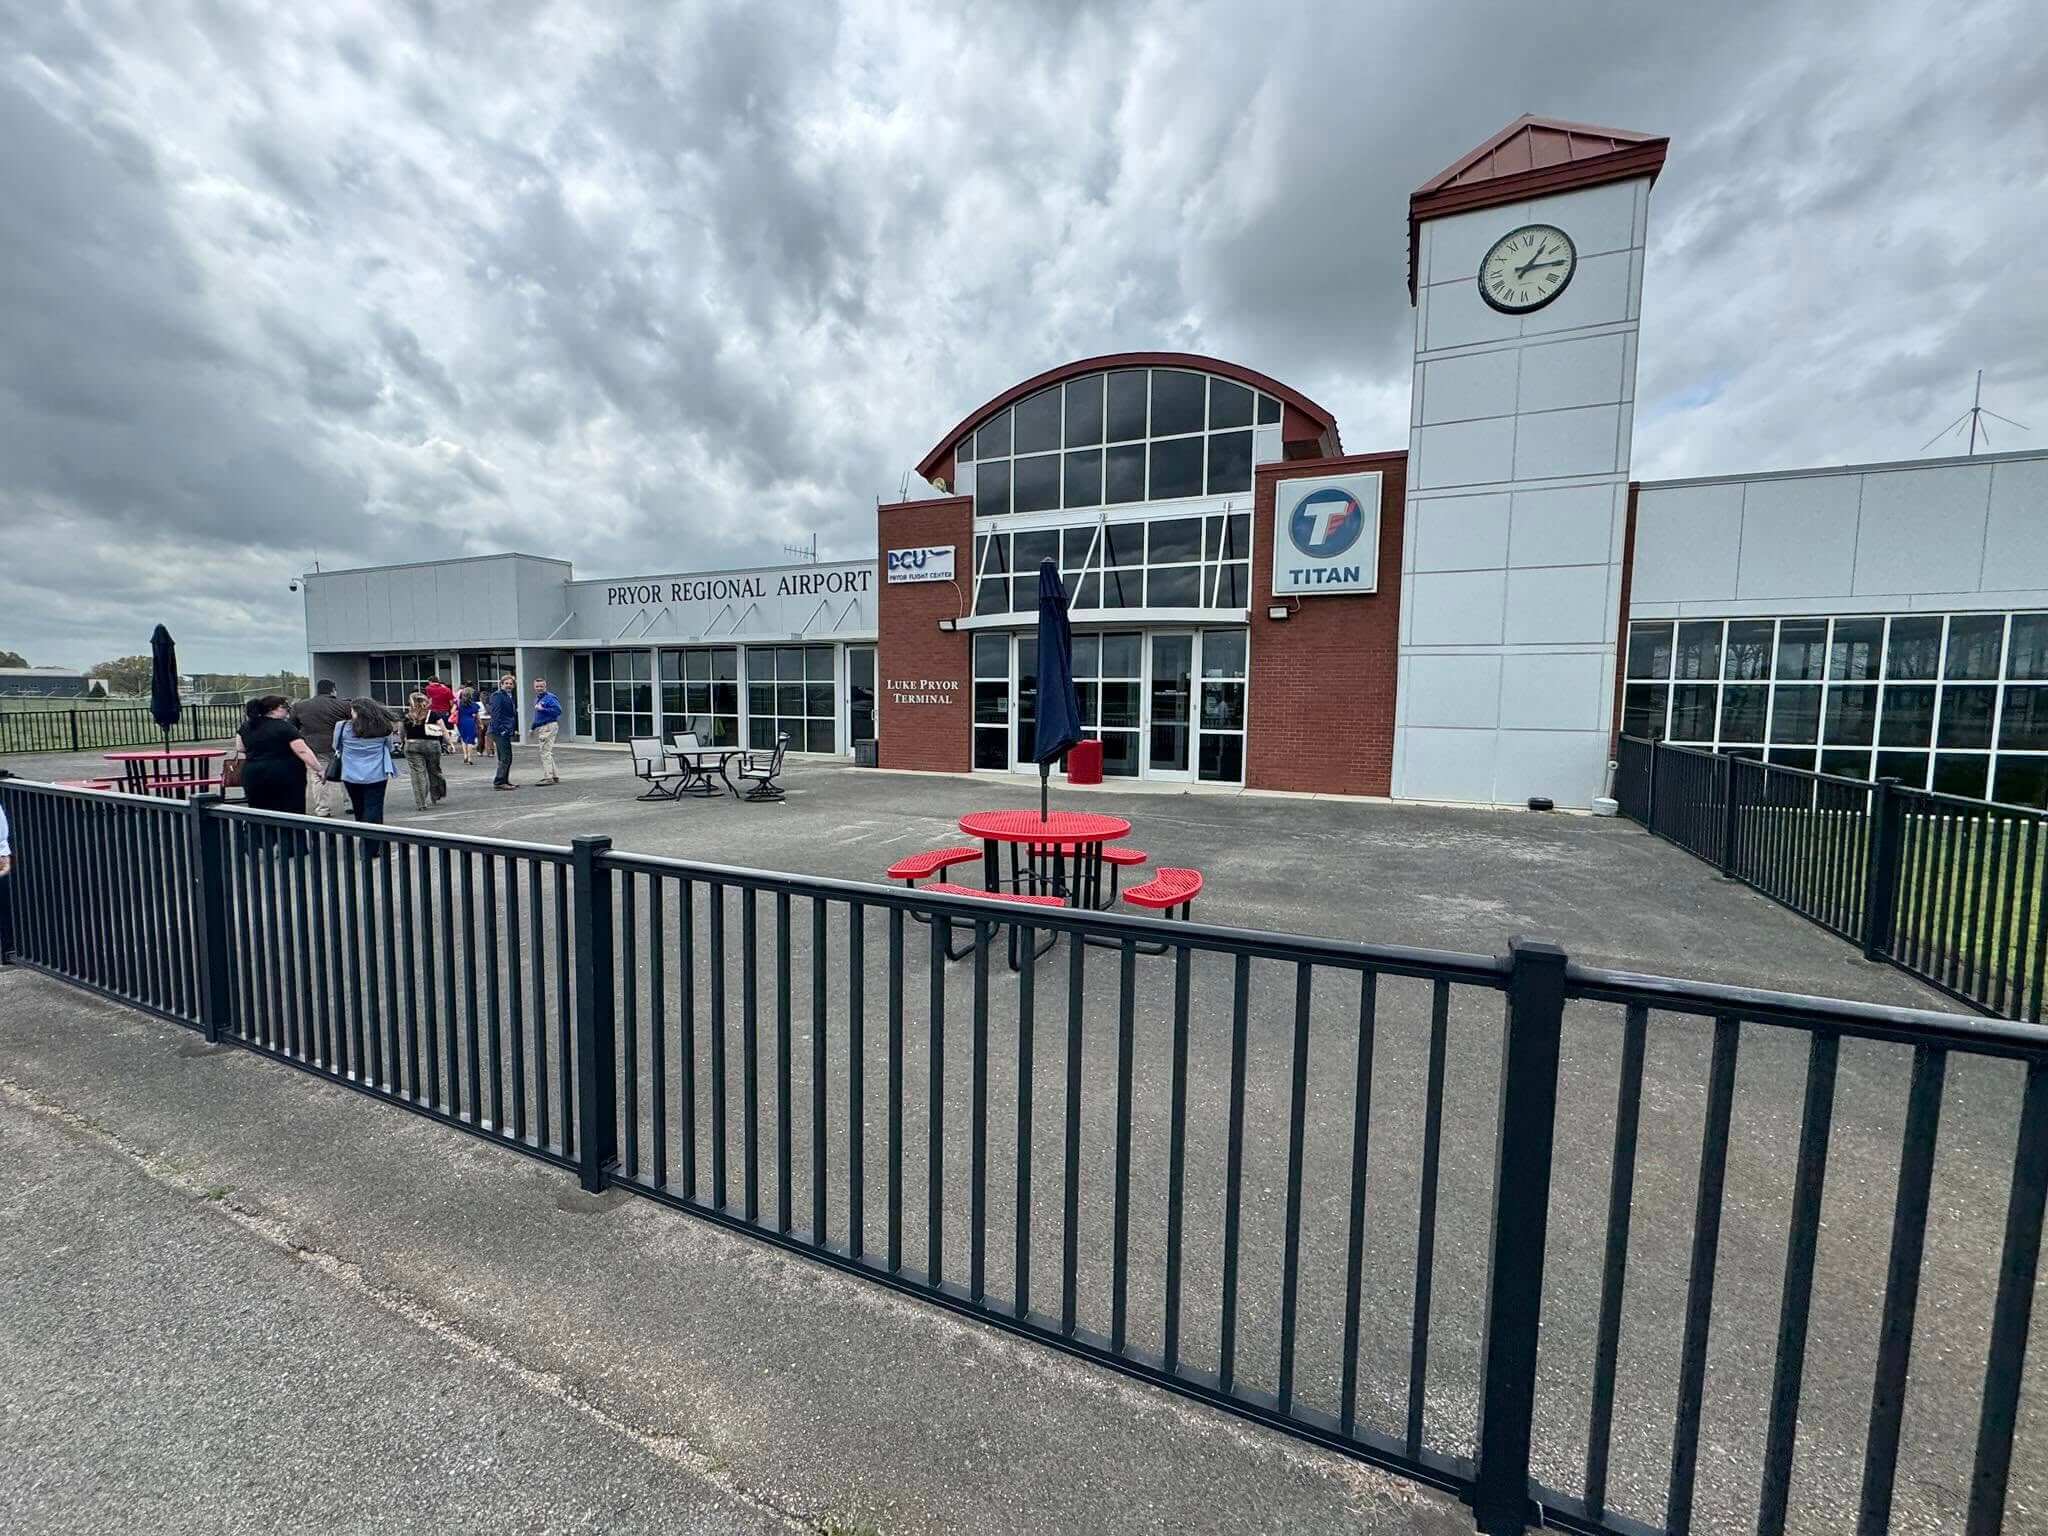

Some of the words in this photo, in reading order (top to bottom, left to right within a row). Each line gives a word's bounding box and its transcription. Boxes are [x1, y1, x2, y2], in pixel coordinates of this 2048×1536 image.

[888, 550, 926, 570] DCU
[1289, 566, 1360, 585] TITAN
[607, 586, 662, 606] PRYOR
[671, 577, 766, 602] REGIONAL
[776, 570, 872, 596] AIRPORT
[887, 679, 917, 690] LUKE
[920, 679, 959, 690] PRYOR
[893, 693, 953, 704] TERMINAL
